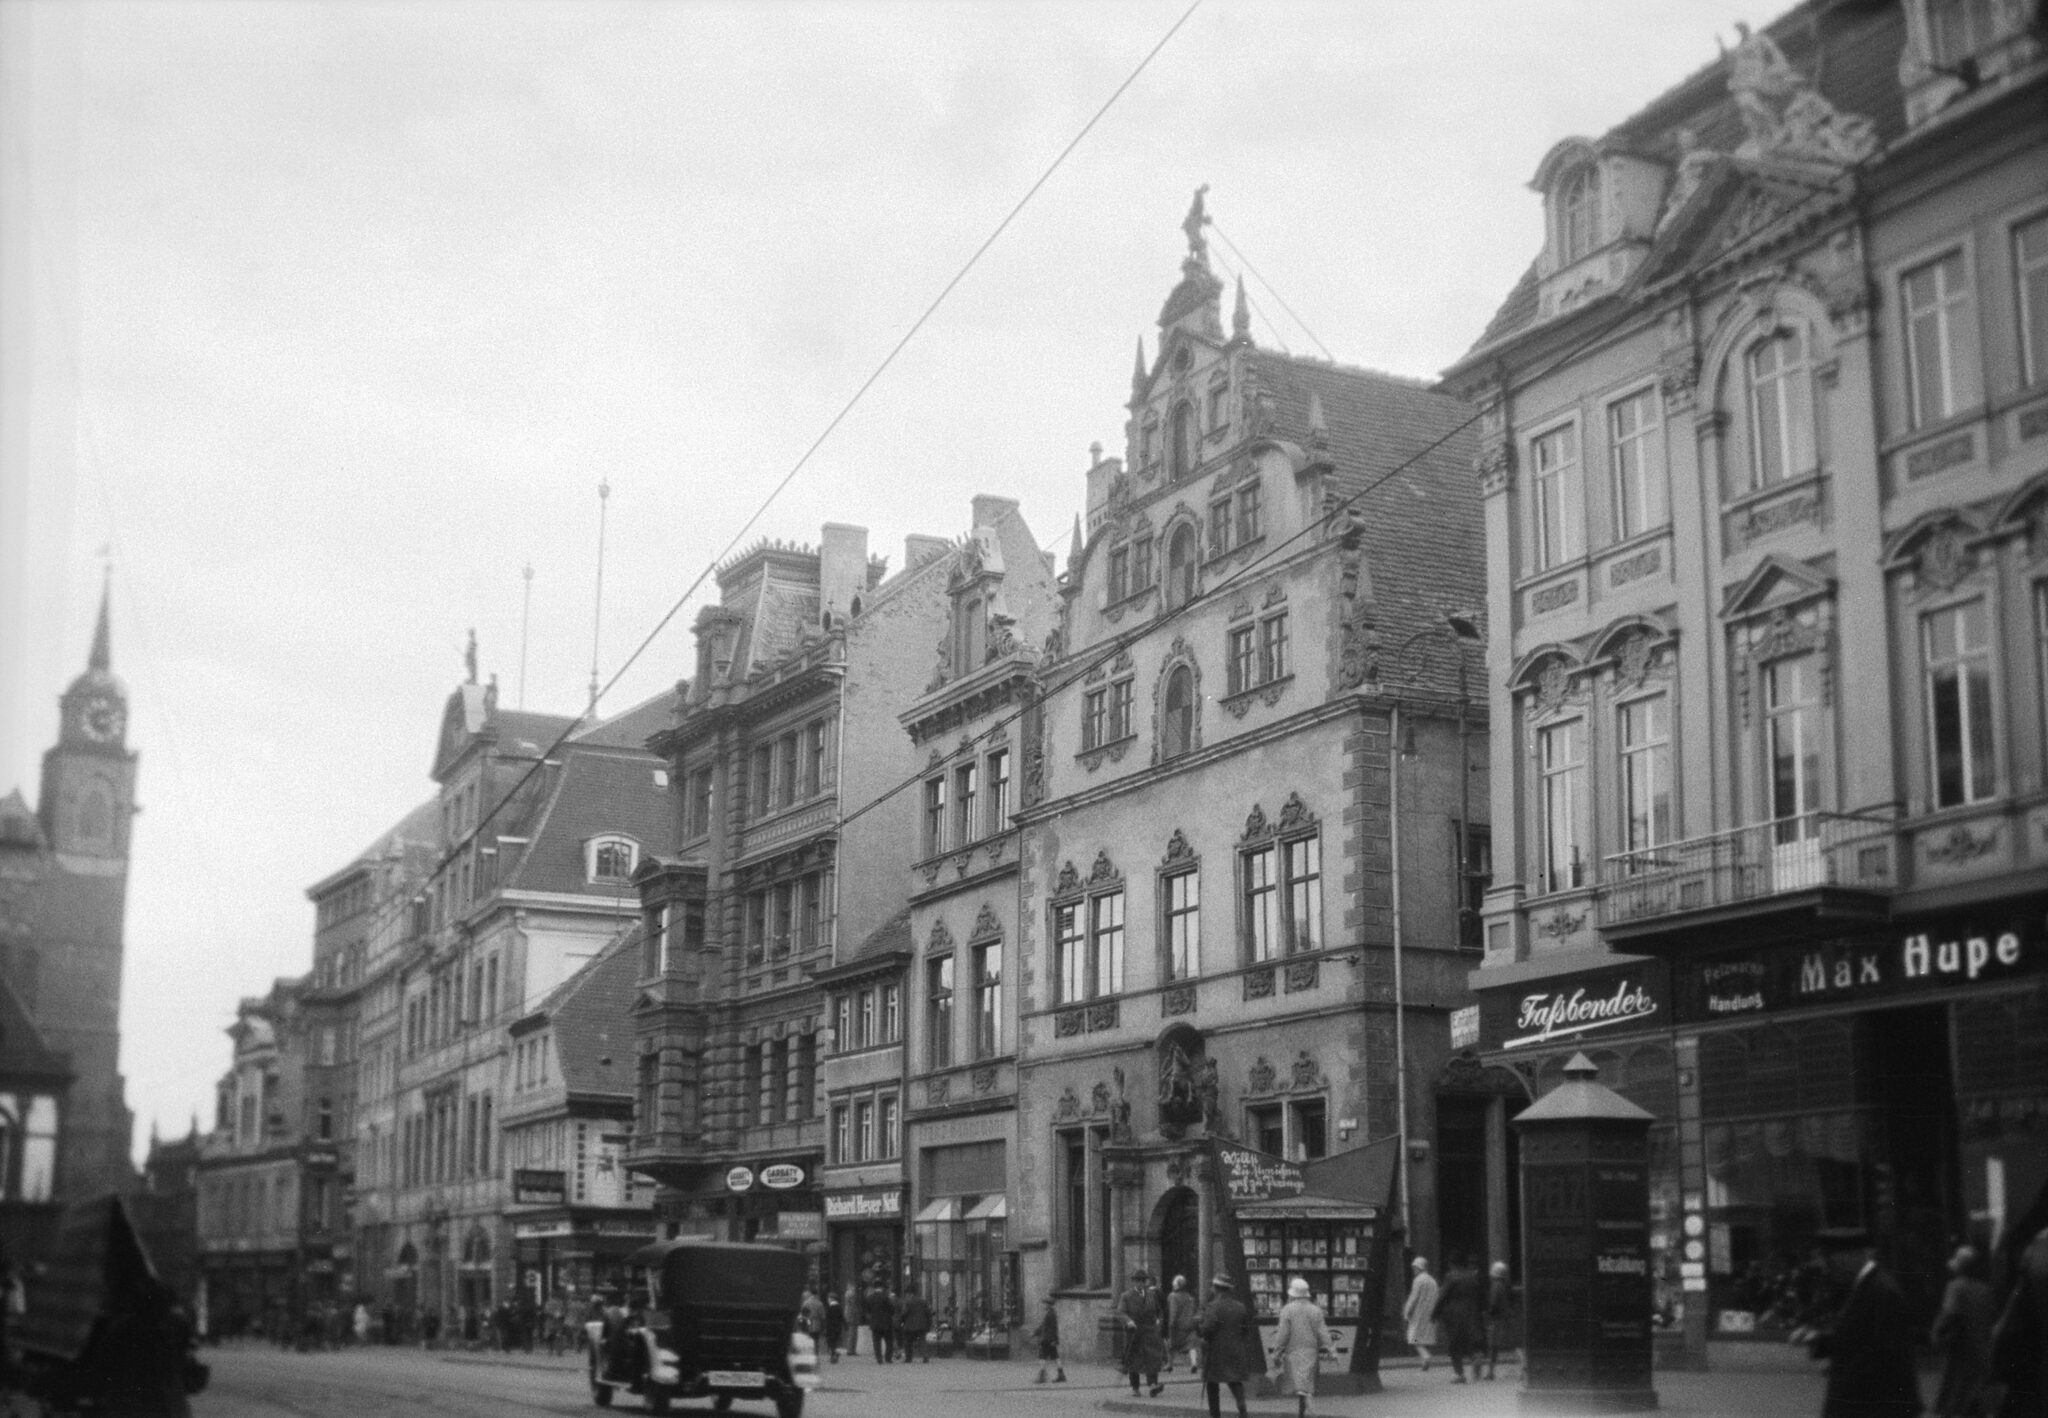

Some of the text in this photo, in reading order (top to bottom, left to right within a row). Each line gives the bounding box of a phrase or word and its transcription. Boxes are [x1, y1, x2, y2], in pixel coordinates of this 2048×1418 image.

[1801, 932, 2021, 992] Max Hupe
[1708, 991, 1764, 1011] Handlung
[825, 1194, 856, 1216] Richard
